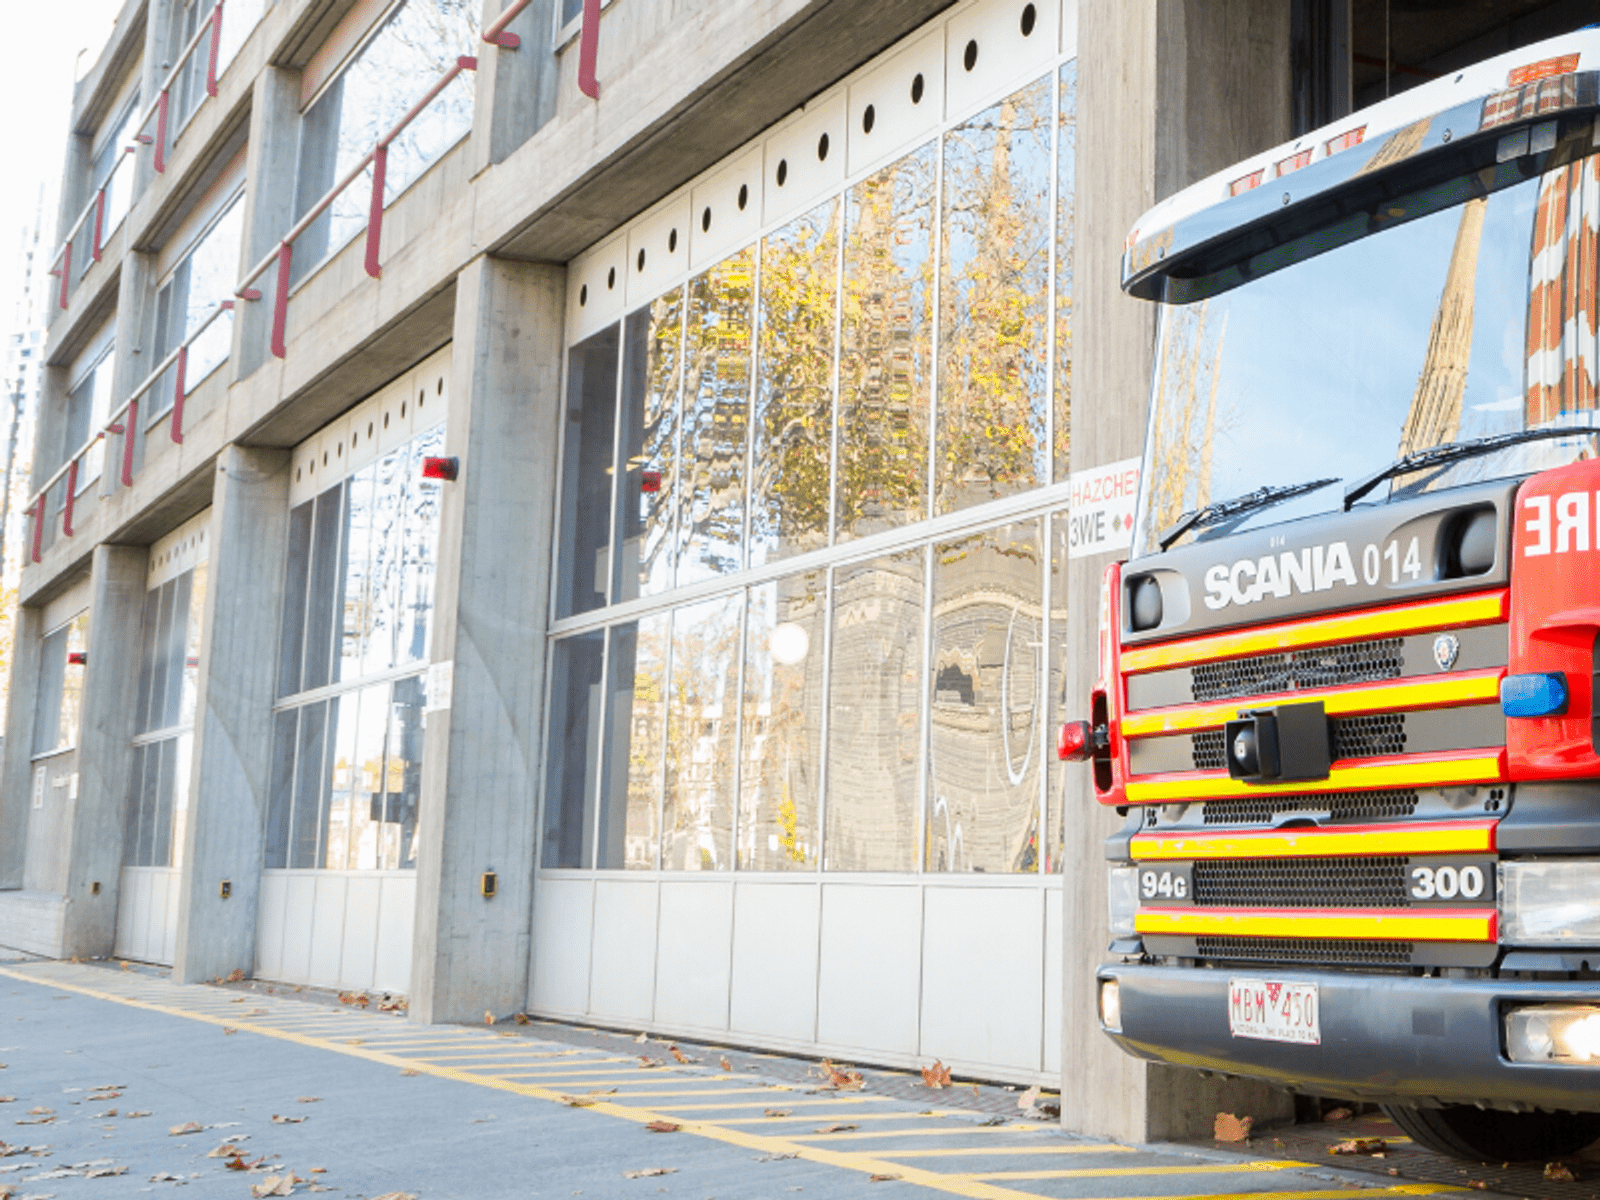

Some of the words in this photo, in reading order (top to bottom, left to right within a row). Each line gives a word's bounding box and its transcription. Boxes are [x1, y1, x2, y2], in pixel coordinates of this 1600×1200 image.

[1070, 510, 1105, 547] 3WE
[1203, 541, 1358, 610] SCANIA
[1363, 536, 1421, 586] 014
[1411, 866, 1484, 899] 300
[1232, 988, 1265, 1023] MBM
[1281, 991, 1314, 1027] 450
